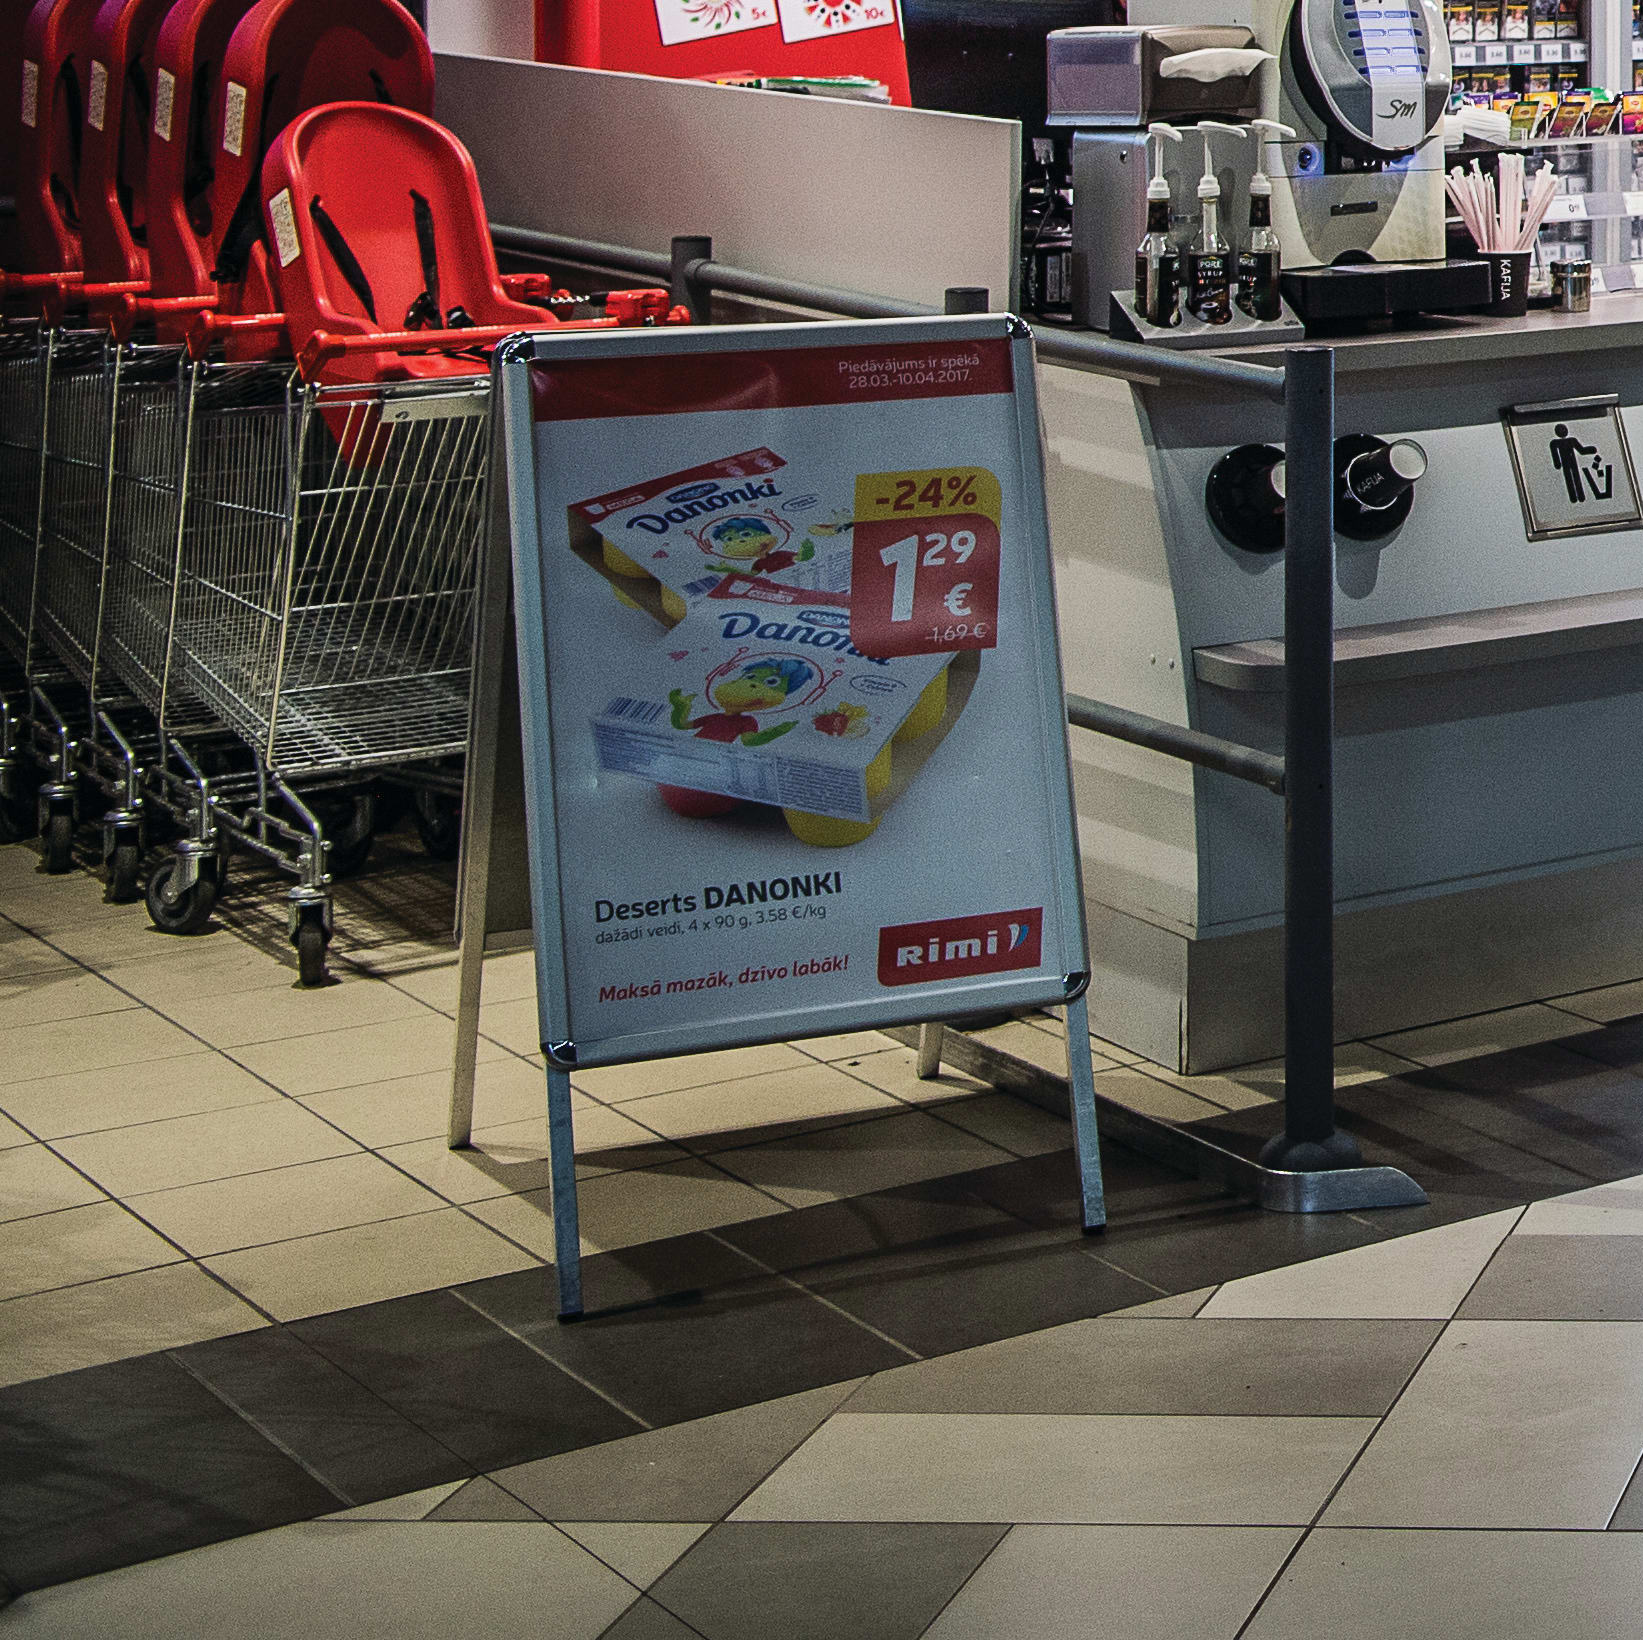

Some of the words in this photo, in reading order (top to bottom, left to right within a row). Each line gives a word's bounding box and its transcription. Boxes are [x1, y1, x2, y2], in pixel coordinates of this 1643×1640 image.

[1499, 259, 1512, 301] KAFIJA
[839, 358, 925, 376] Piedāvājums
[929, 357, 937, 368] ir
[941, 355, 980, 372] spēkā
[875, 475, 978, 511] -24%
[1356, 471, 1384, 495] KAFIJA
[626, 478, 782, 535] Danonki
[879, 534, 919, 622] 1
[923, 530, 977, 566] 29
[944, 582, 973, 617] €
[718, 611, 889, 665] Danon
[931, 623, 968, 643] 1,69
[972, 622, 987, 639] €
[595, 894, 697, 923] Deserts
[703, 871, 842, 909] DANONKI
[595, 926, 644, 945] dažādi
[647, 924, 685, 938] veidi,
[688, 919, 699, 932] 4
[703, 921, 711, 931] x
[714, 914, 735, 928] 90
[791, 903, 827, 920] €/kg
[896, 929, 998, 968] Rimi
[599, 980, 662, 1003] Maksā
[666, 970, 733, 995] mazāk,
[738, 962, 788, 985] dzīvo
[792, 954, 850, 978] labāk!
